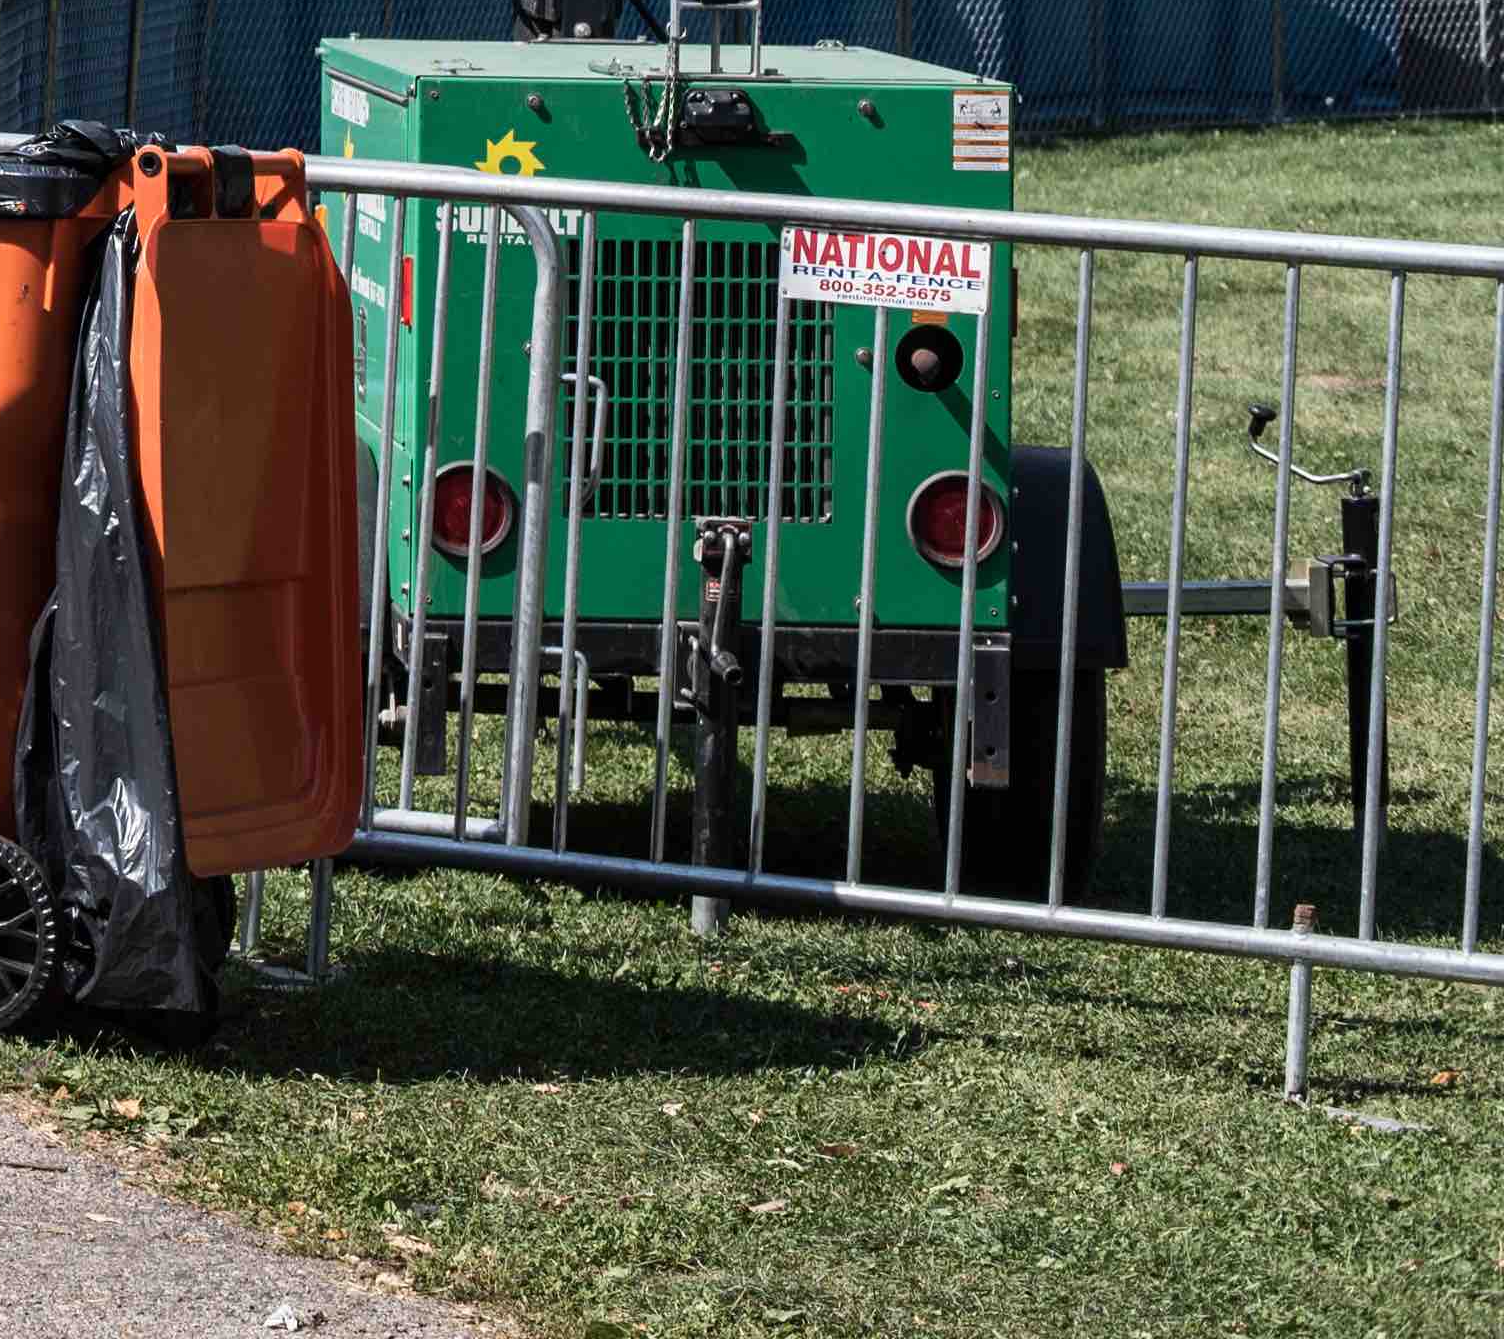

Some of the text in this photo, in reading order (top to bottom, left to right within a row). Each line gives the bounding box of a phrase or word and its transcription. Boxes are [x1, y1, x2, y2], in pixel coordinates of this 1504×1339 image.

[436, 205, 583, 235] SULT
[467, 234, 532, 245] RETA
[793, 228, 981, 279] NATIONAL
[793, 265, 984, 291] RENT-A-FENCE
[819, 279, 952, 302] 800-352-5675
